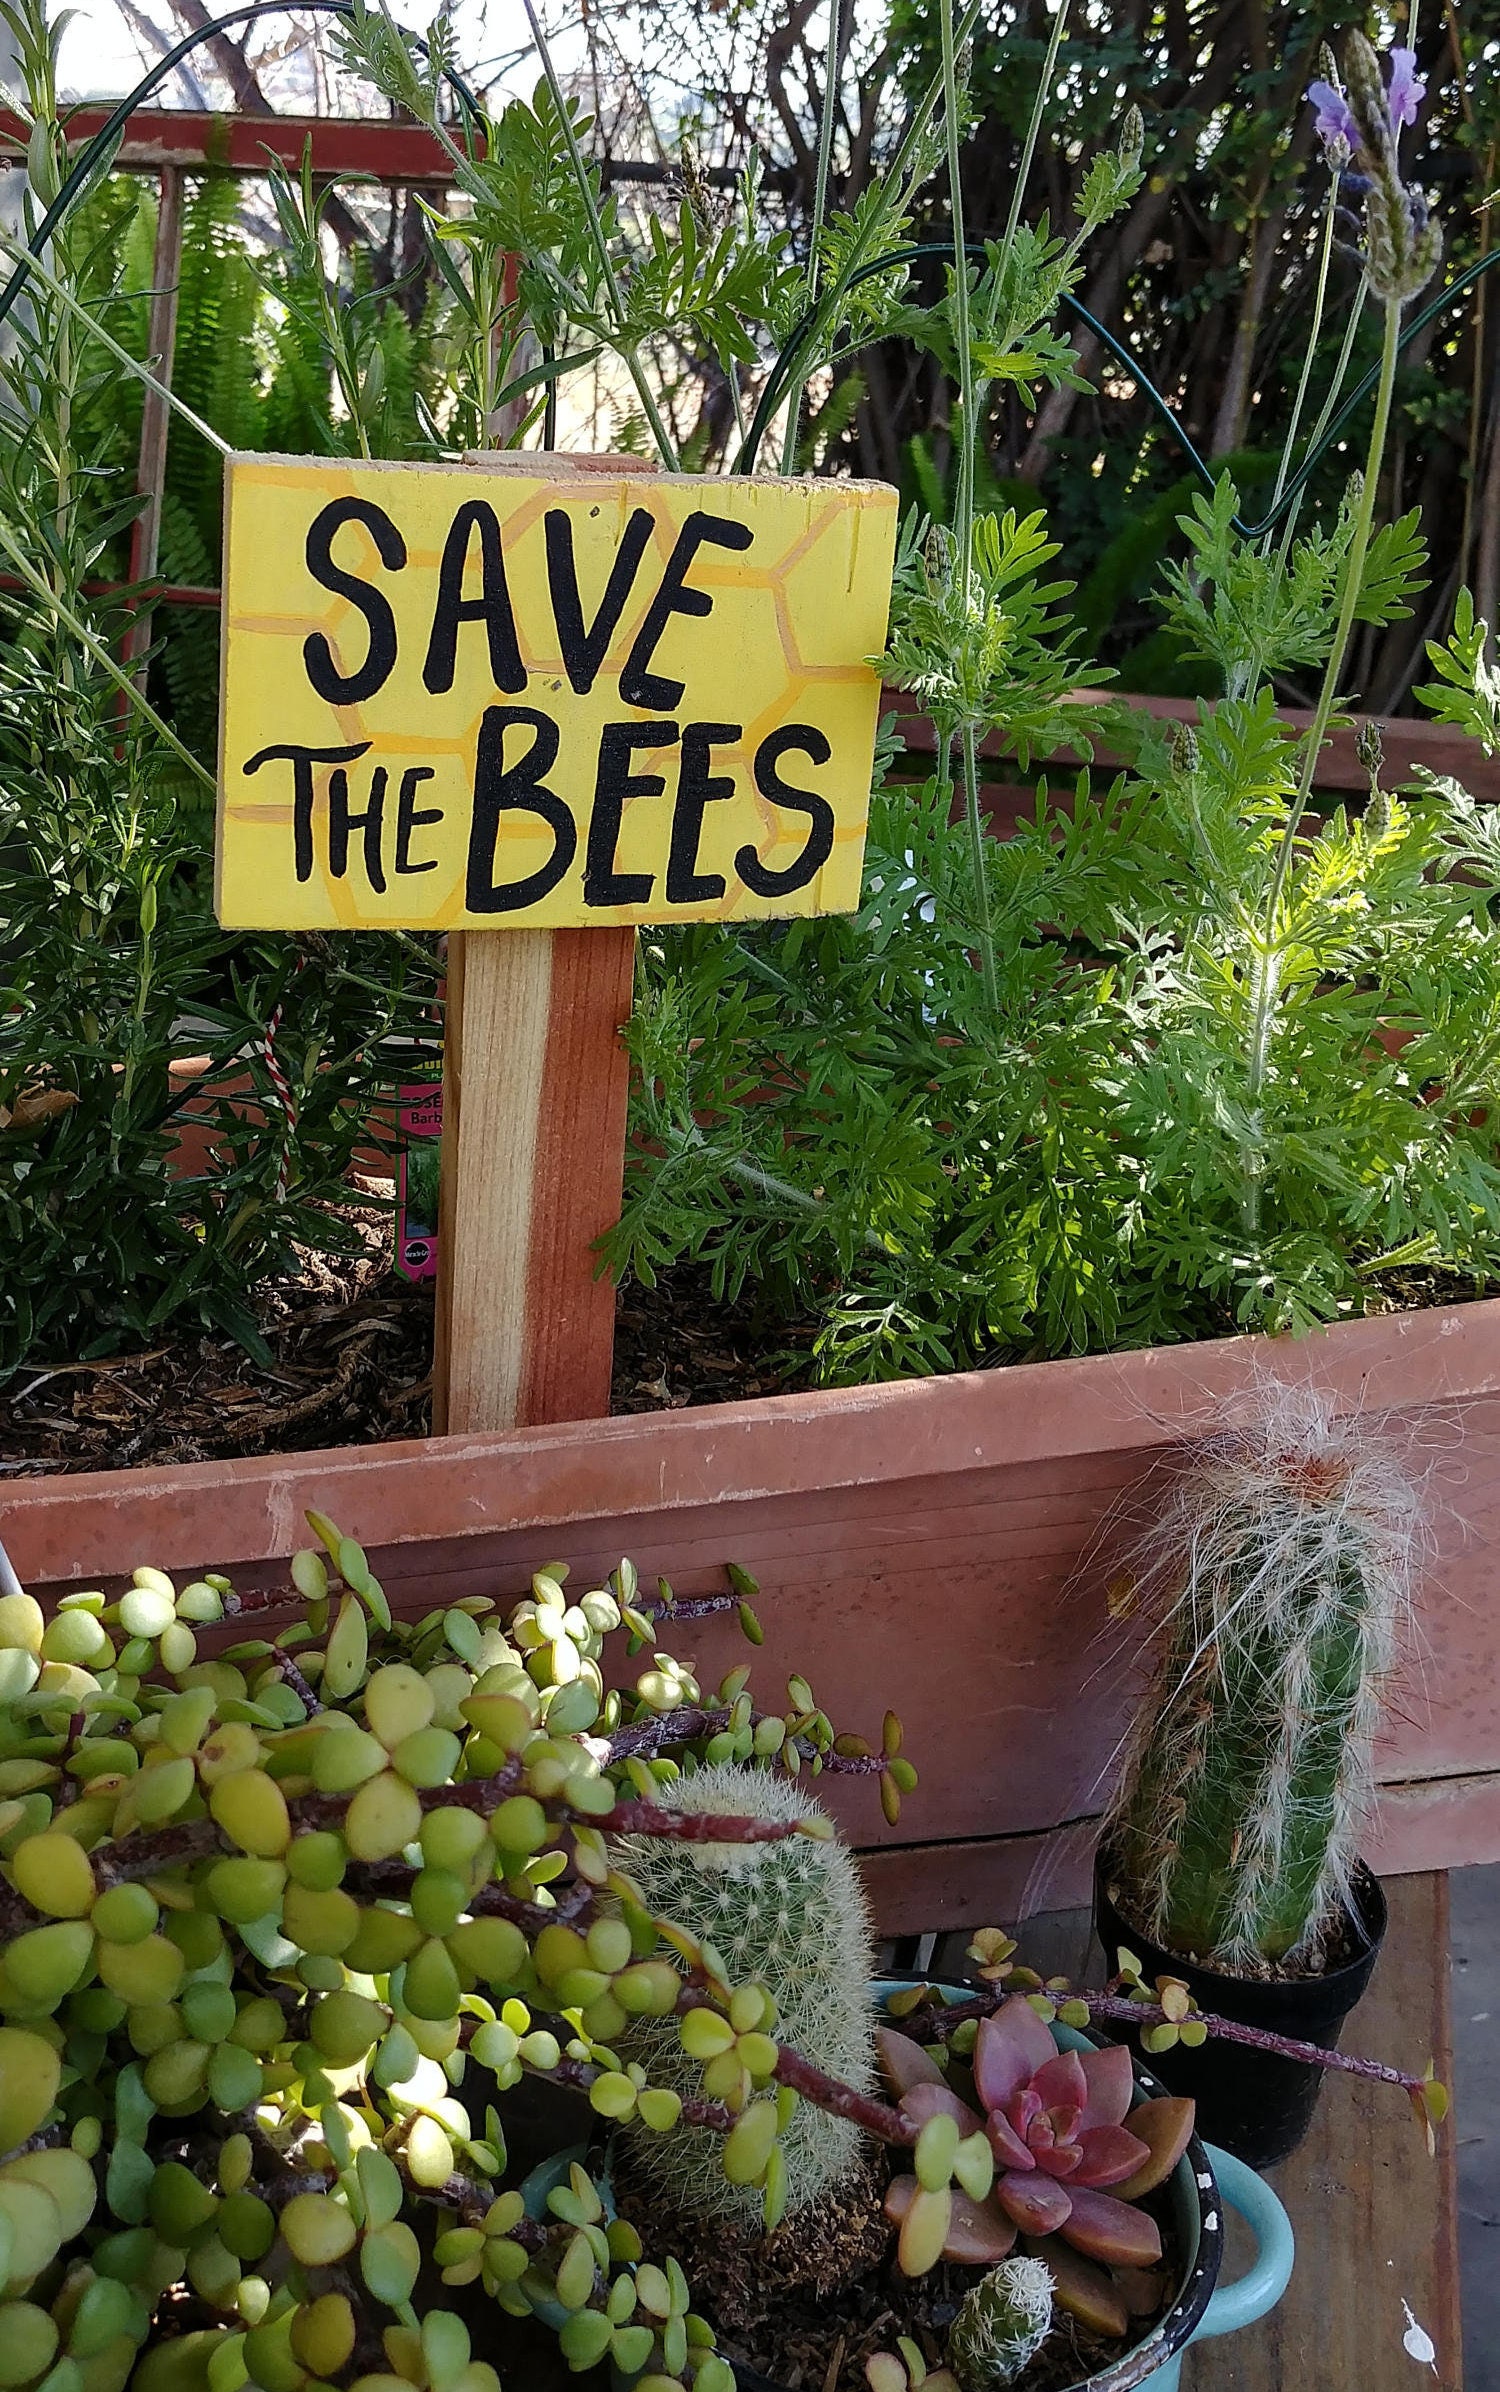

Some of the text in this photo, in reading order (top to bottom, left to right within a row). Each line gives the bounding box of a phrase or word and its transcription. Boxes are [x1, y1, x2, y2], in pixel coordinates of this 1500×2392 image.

[303, 496, 754, 711] SAVE
[243, 705, 835, 914] THE BEES
